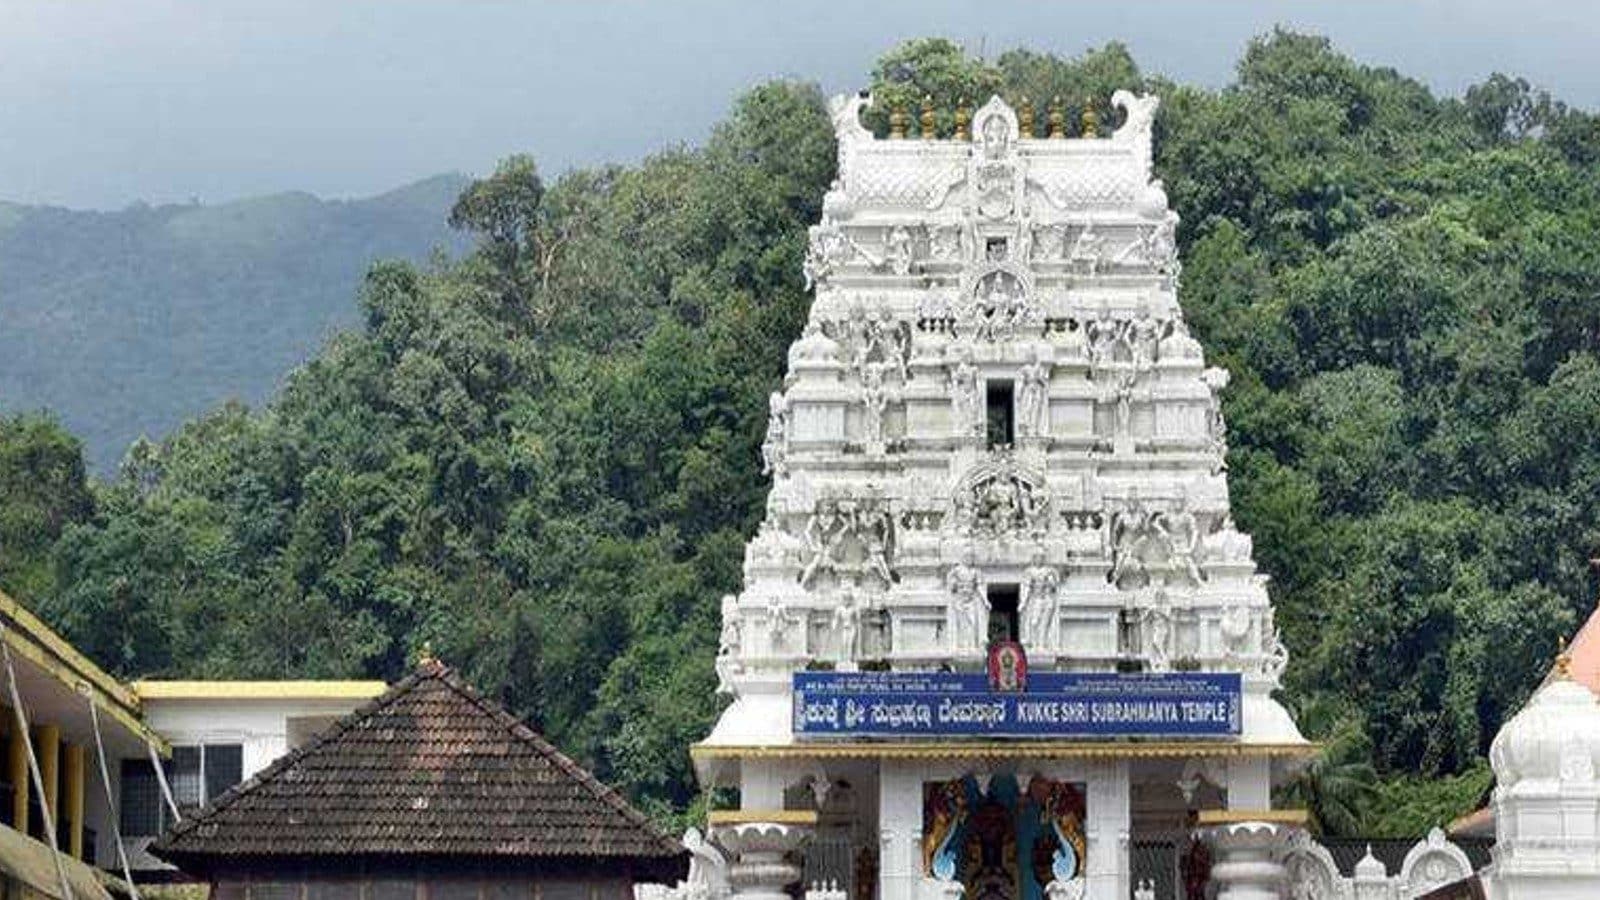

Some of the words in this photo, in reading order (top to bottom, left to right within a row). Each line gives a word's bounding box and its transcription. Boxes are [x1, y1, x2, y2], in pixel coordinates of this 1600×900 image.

[1017, 701, 1058, 722] KUKKE
[1061, 701, 1088, 722] SHRI
[1091, 701, 1178, 722] SUBRAHMANYA
[1180, 701, 1226, 722] TEMPLE
